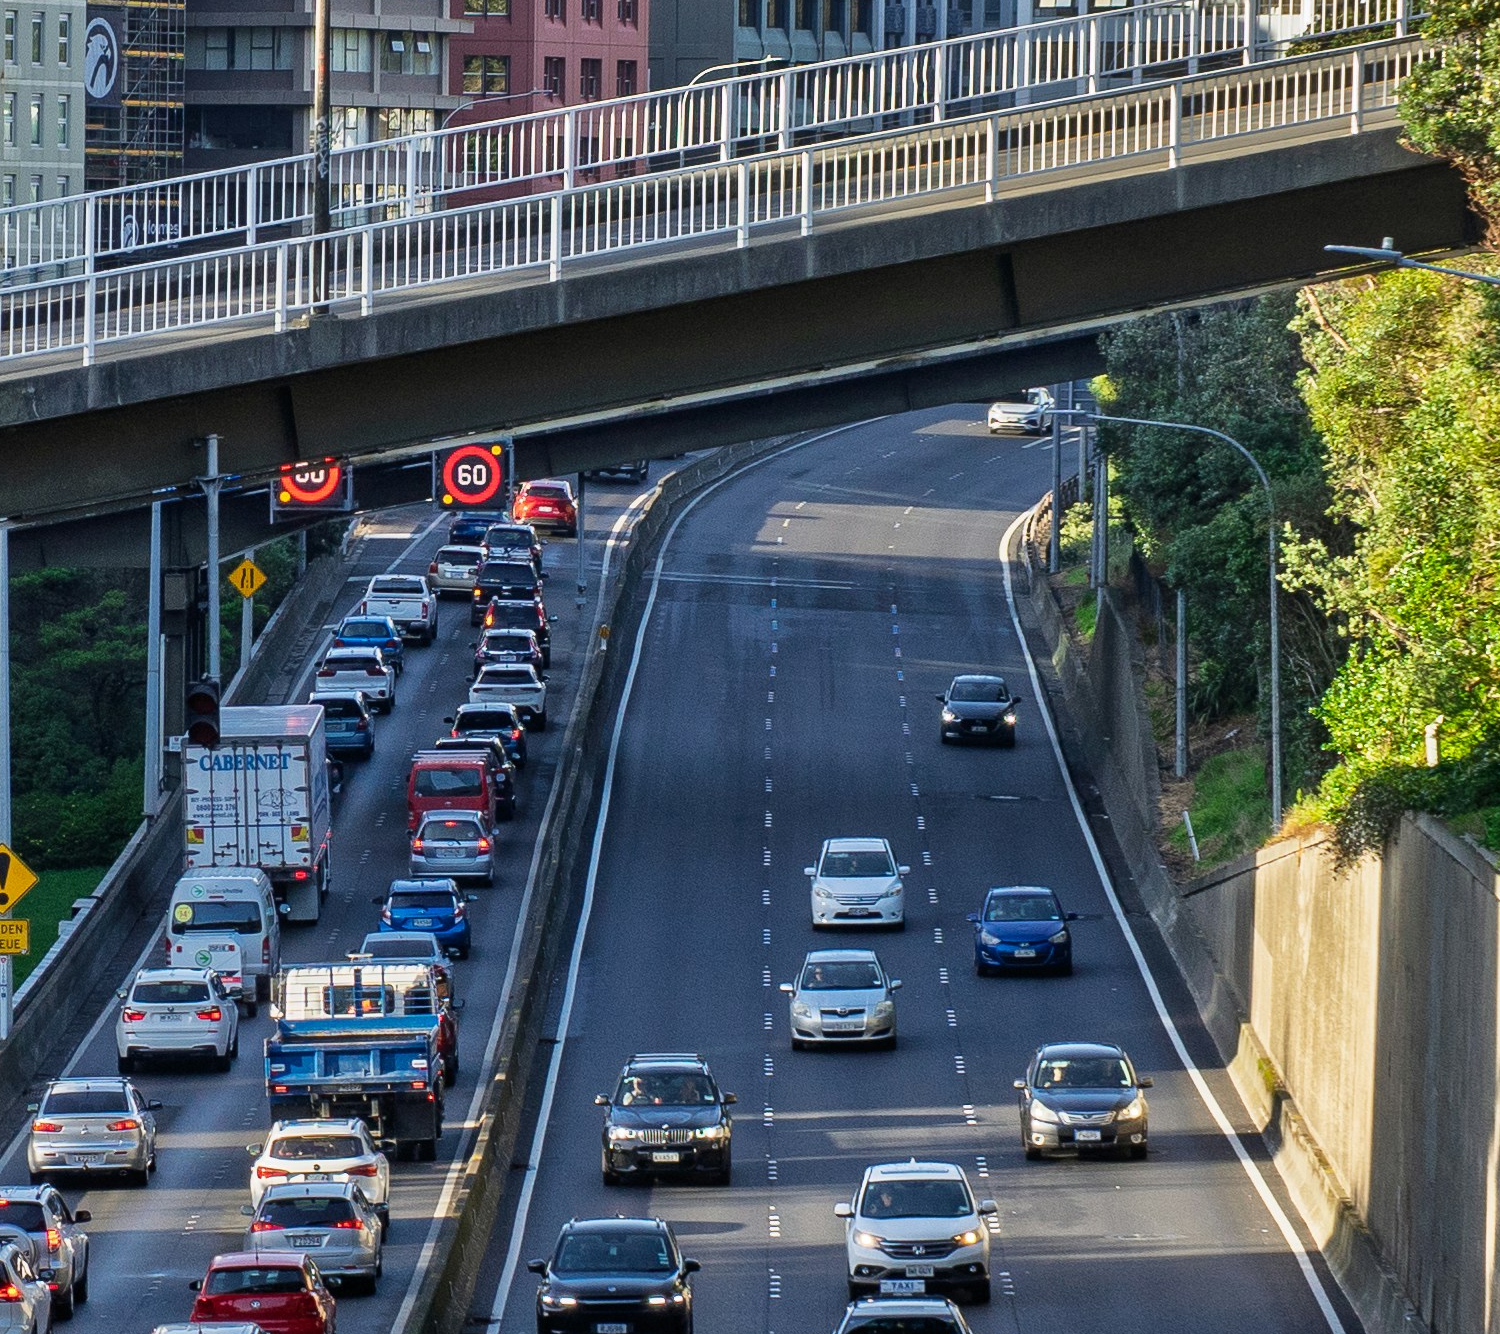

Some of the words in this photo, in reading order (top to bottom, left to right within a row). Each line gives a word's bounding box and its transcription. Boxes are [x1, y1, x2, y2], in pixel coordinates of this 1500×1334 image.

[457, 464, 487, 486] 60
[200, 753, 291, 771] CABERNET
[892, 1281, 914, 1289] TAXI
